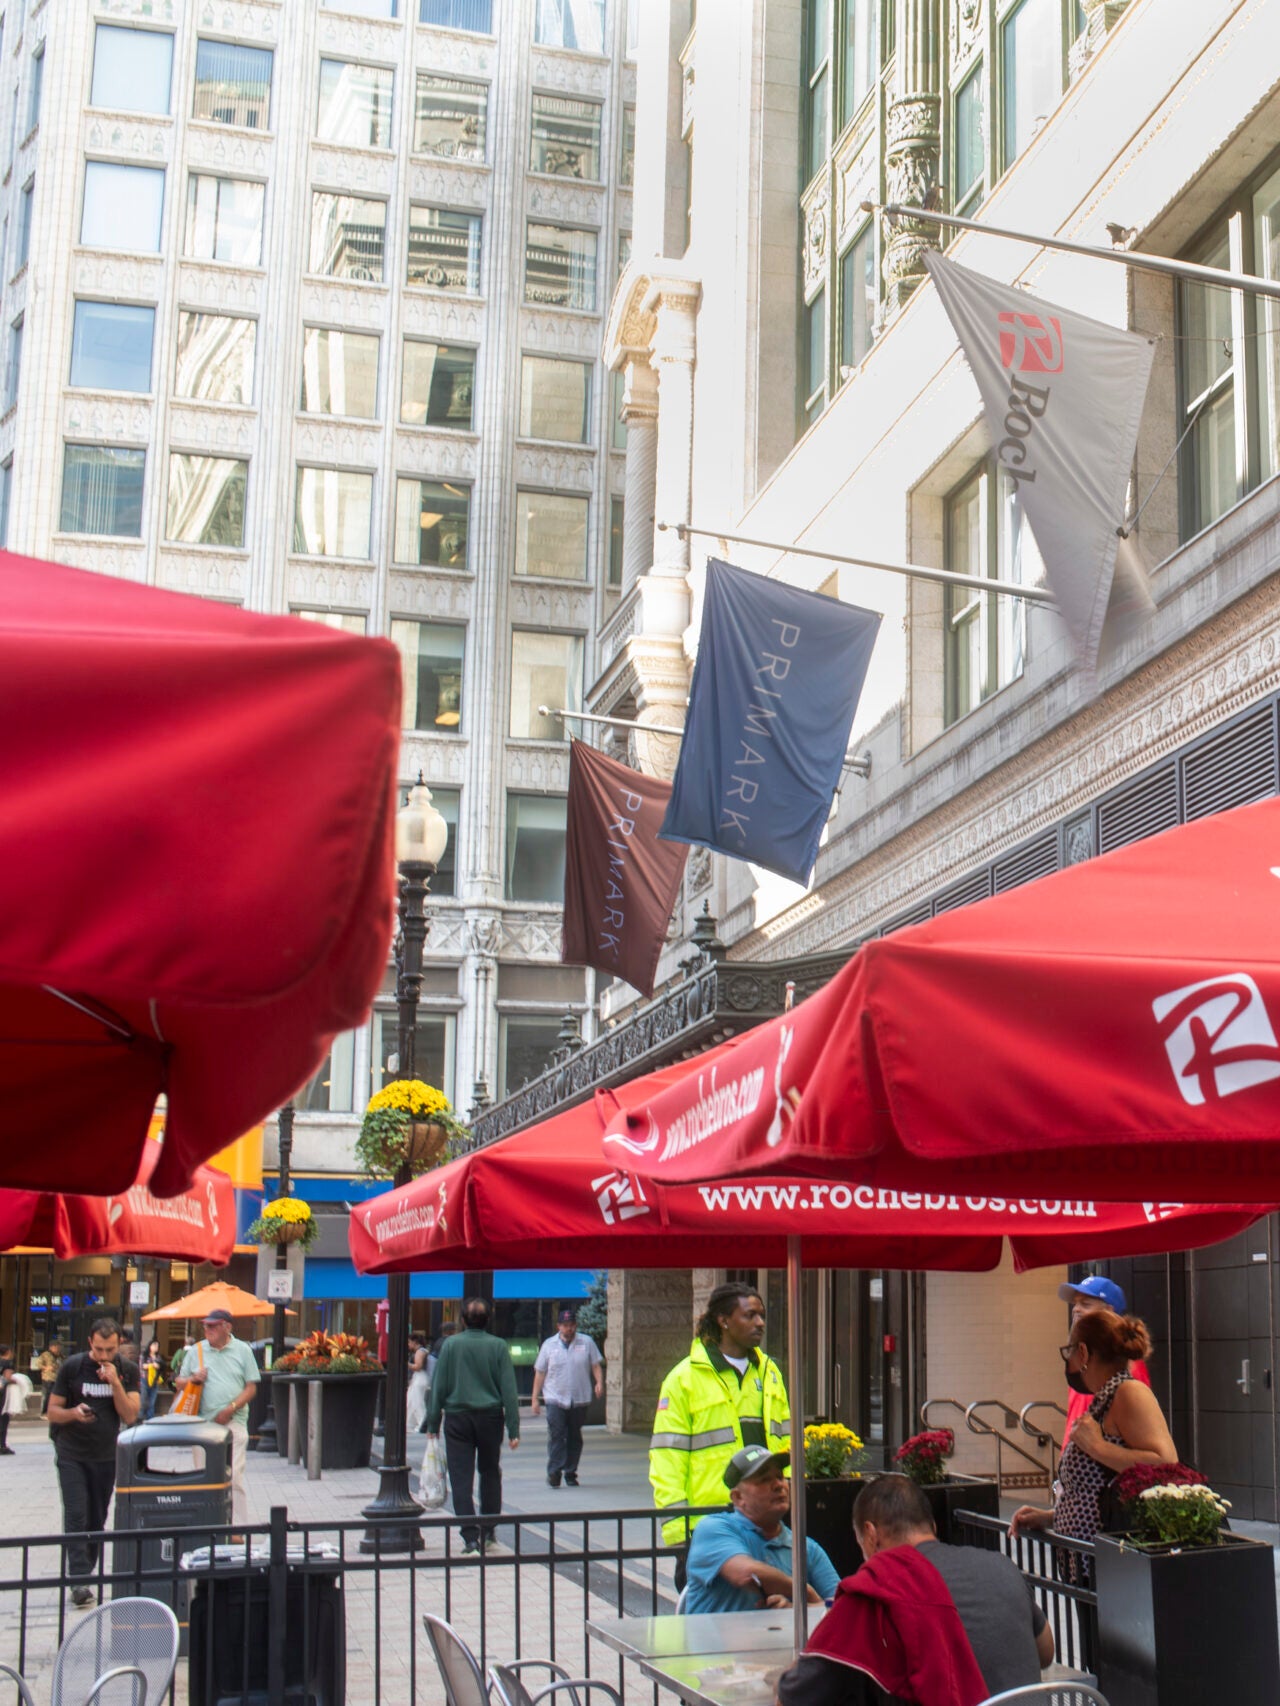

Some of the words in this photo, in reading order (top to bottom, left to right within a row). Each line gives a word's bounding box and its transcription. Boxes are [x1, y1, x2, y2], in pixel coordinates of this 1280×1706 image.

[720, 618, 801, 838] PRIMARK
[599, 788, 642, 955] PRIMARK
[157, 1495, 181, 1504] TRASH
